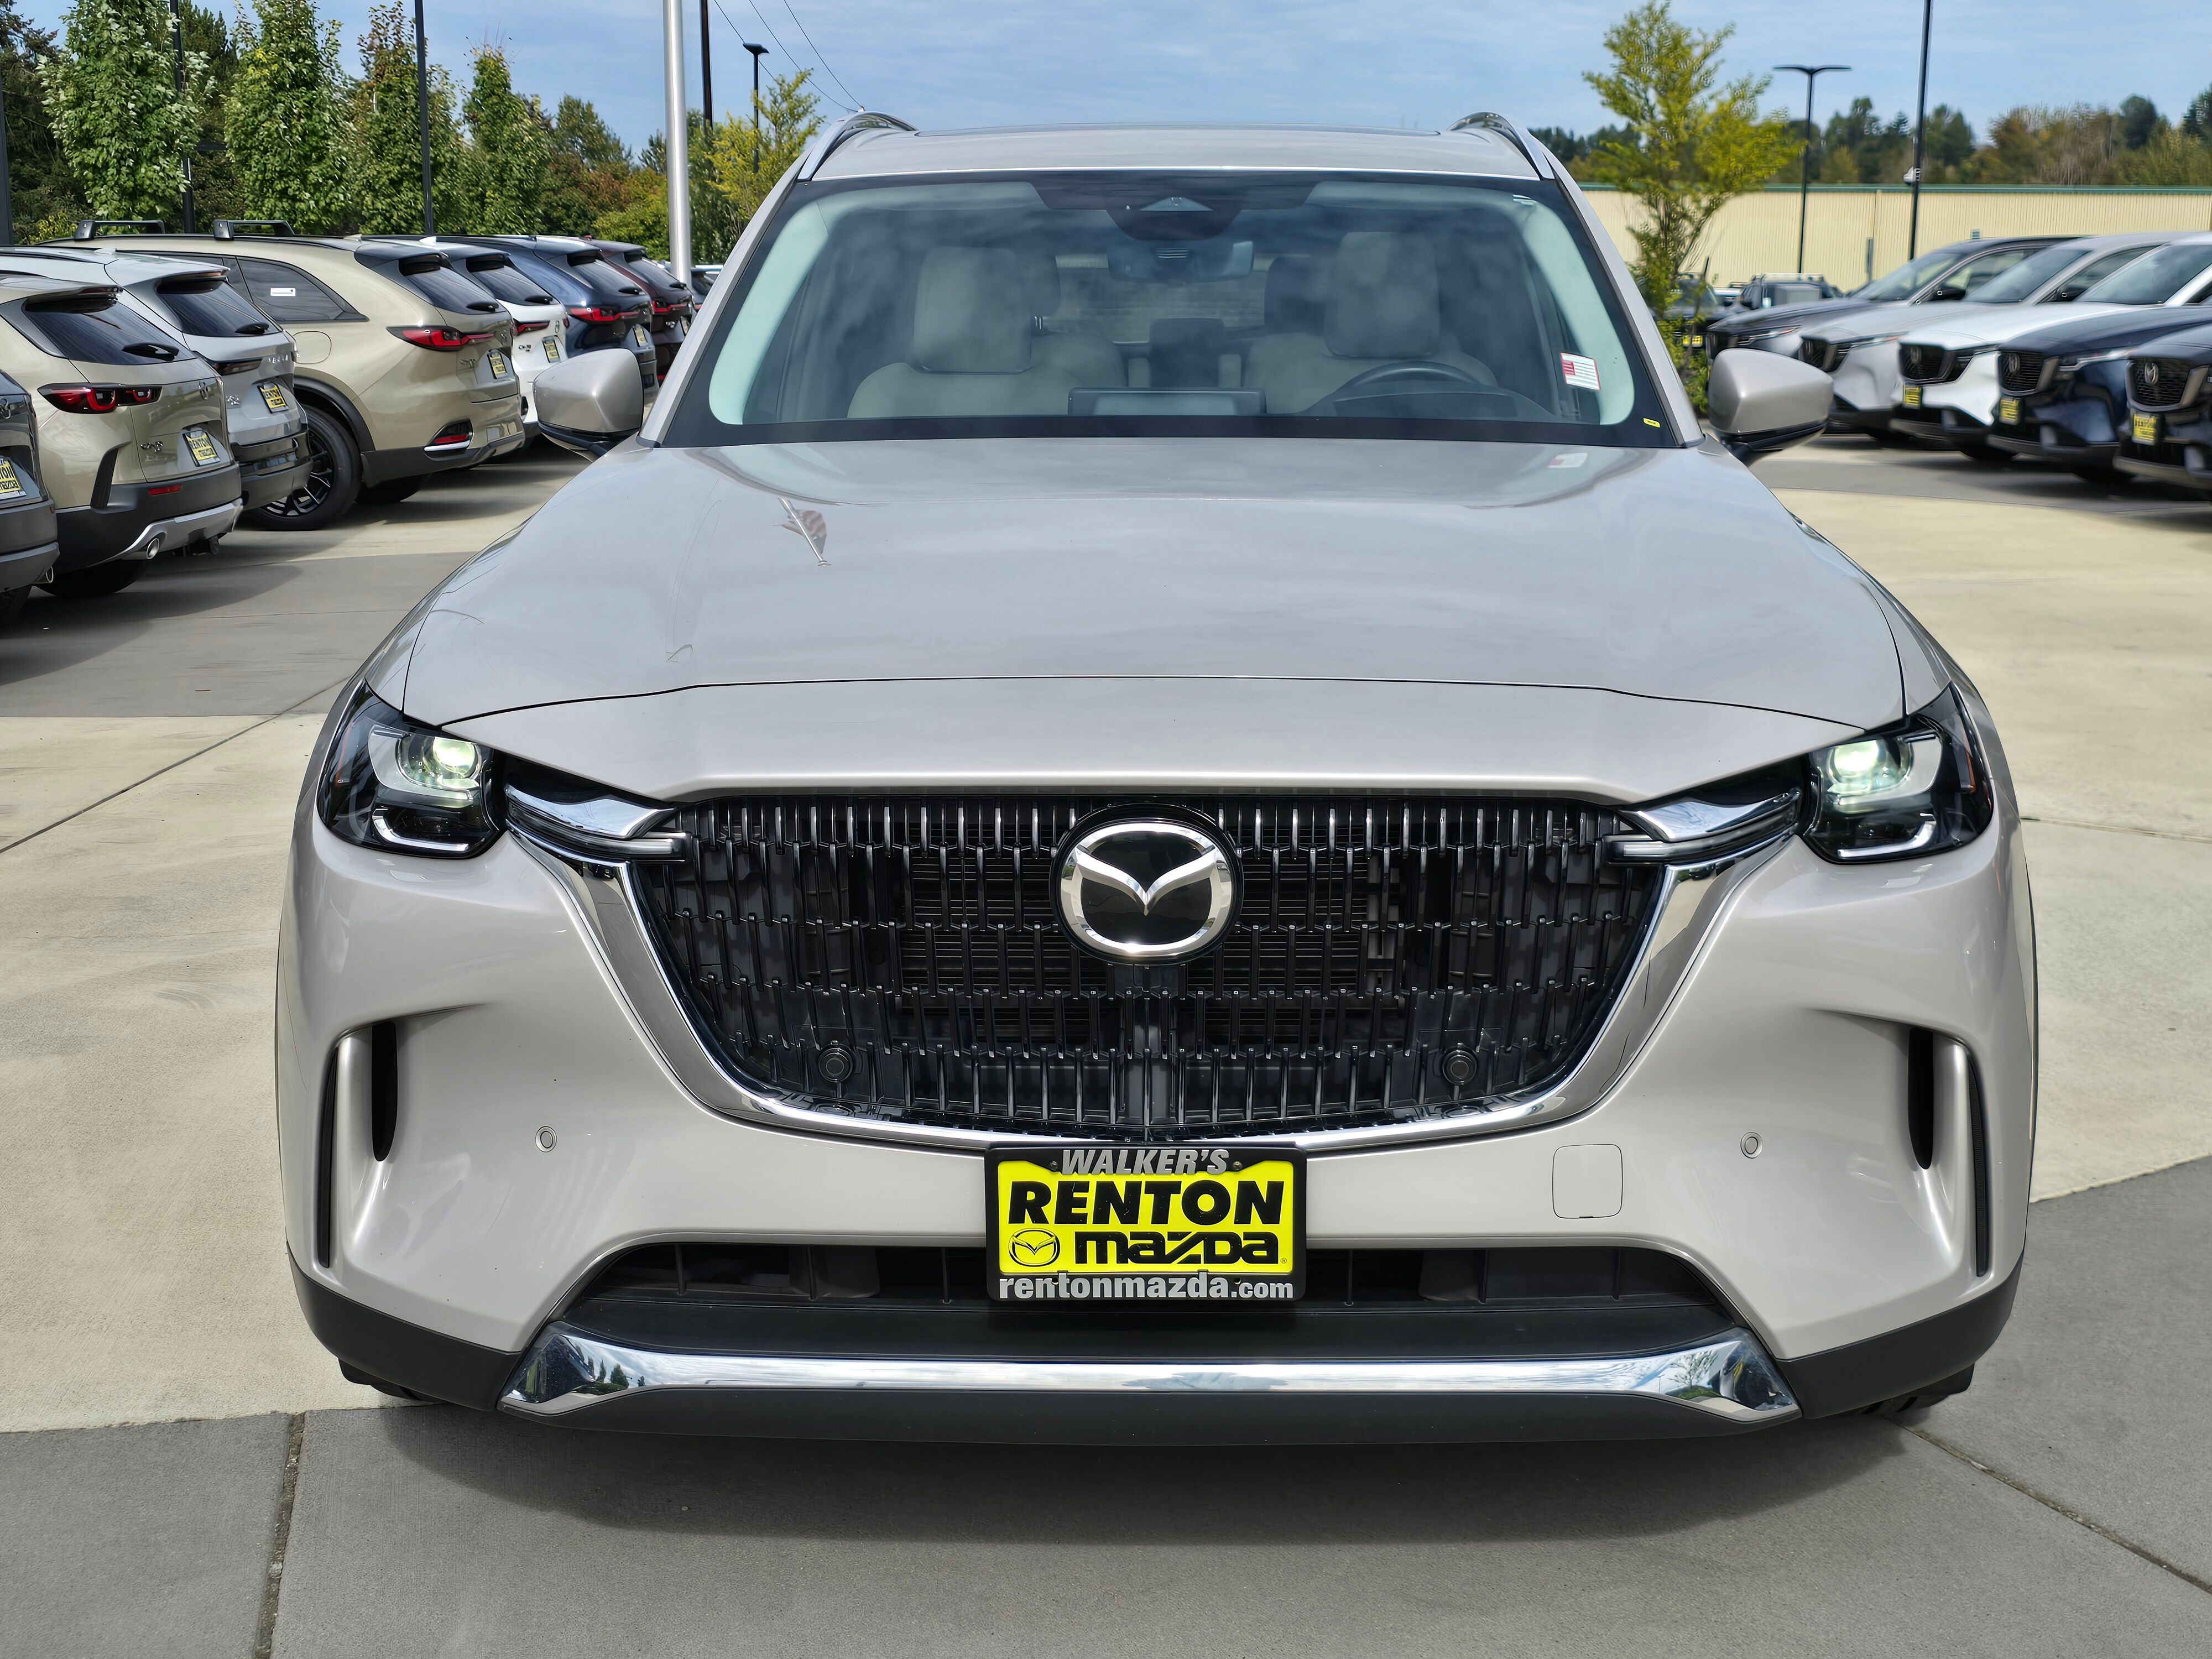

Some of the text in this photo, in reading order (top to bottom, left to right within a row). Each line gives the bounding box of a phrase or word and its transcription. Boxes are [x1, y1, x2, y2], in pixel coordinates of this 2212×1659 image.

[1061, 1149, 1229, 1175] WALKER'S
[1008, 1180, 1284, 1225] RENTON
[1074, 1231, 1279, 1264] mazda
[999, 1272, 1293, 1298] rentonmazda.com
